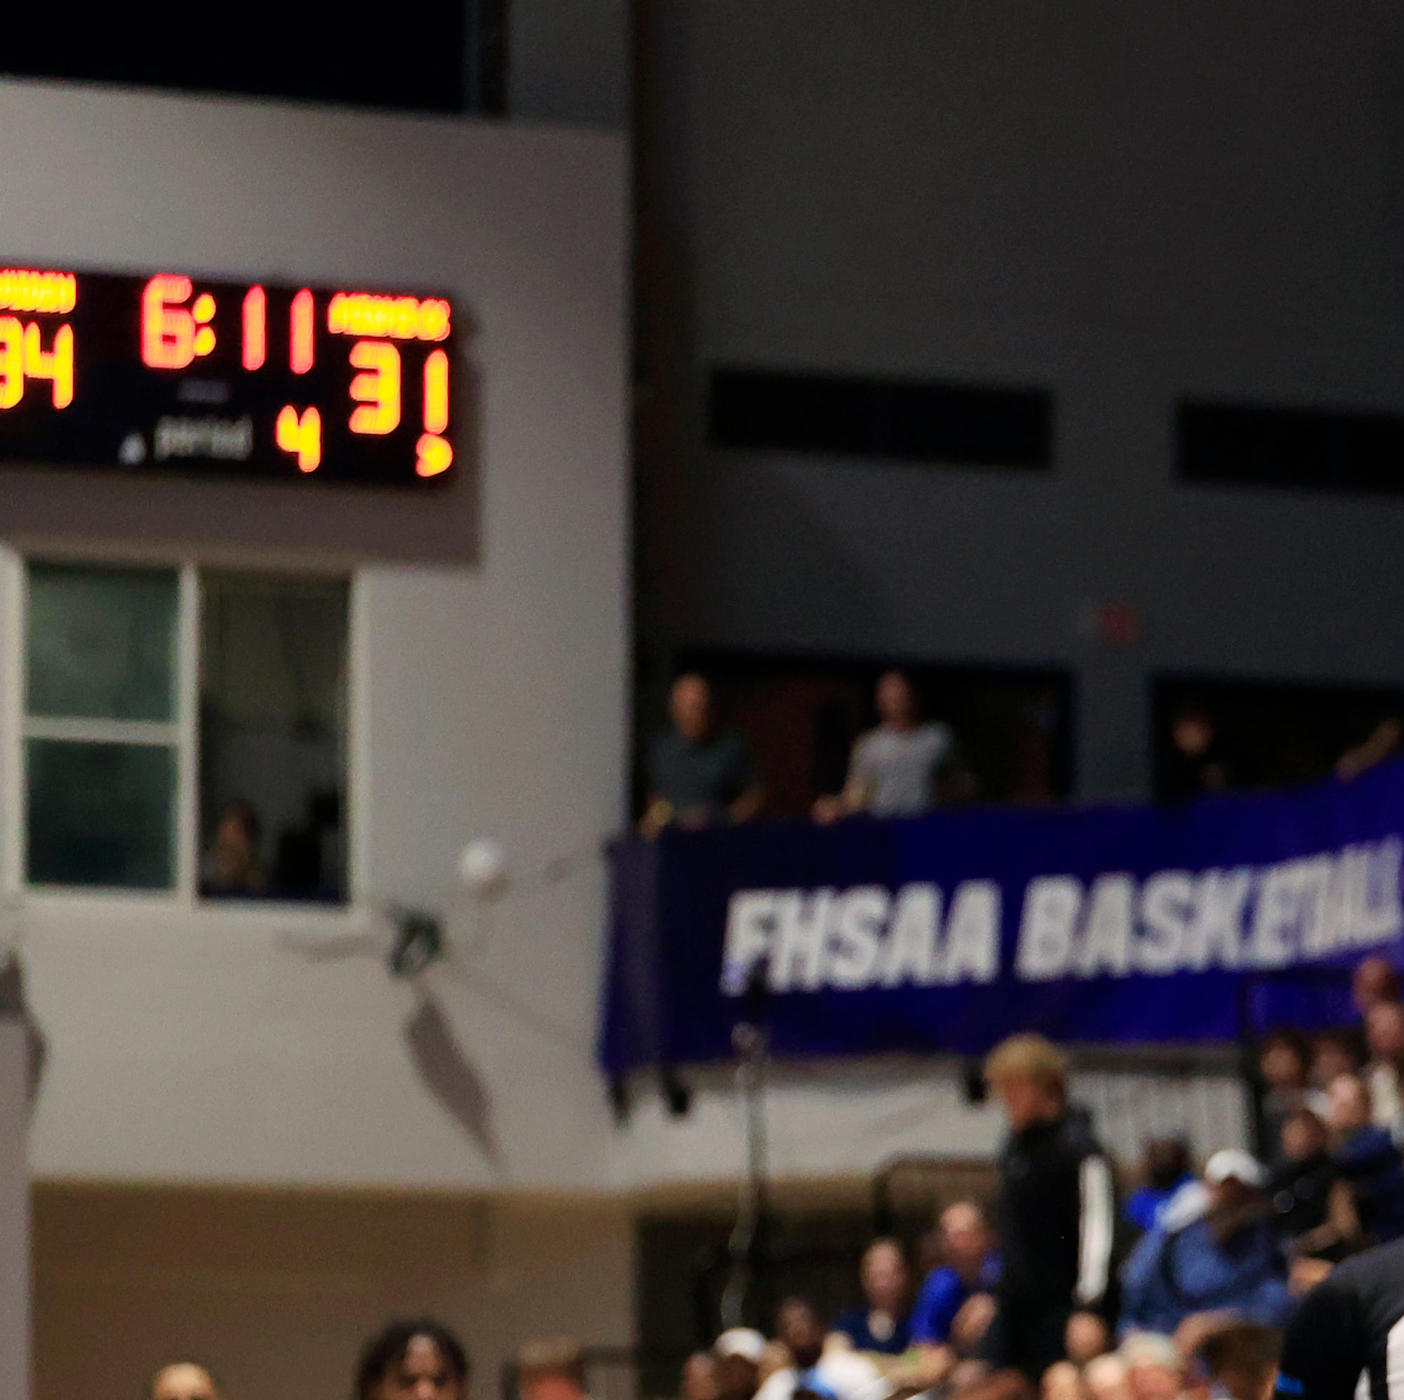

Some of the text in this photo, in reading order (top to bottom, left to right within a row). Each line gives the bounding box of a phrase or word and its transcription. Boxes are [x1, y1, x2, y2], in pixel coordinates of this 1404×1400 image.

[140, 272, 315, 375] 6:11
[348, 340, 450, 436] 31
[275, 404, 322, 473] 4
[720, 878, 1002, 997] FHSAA
